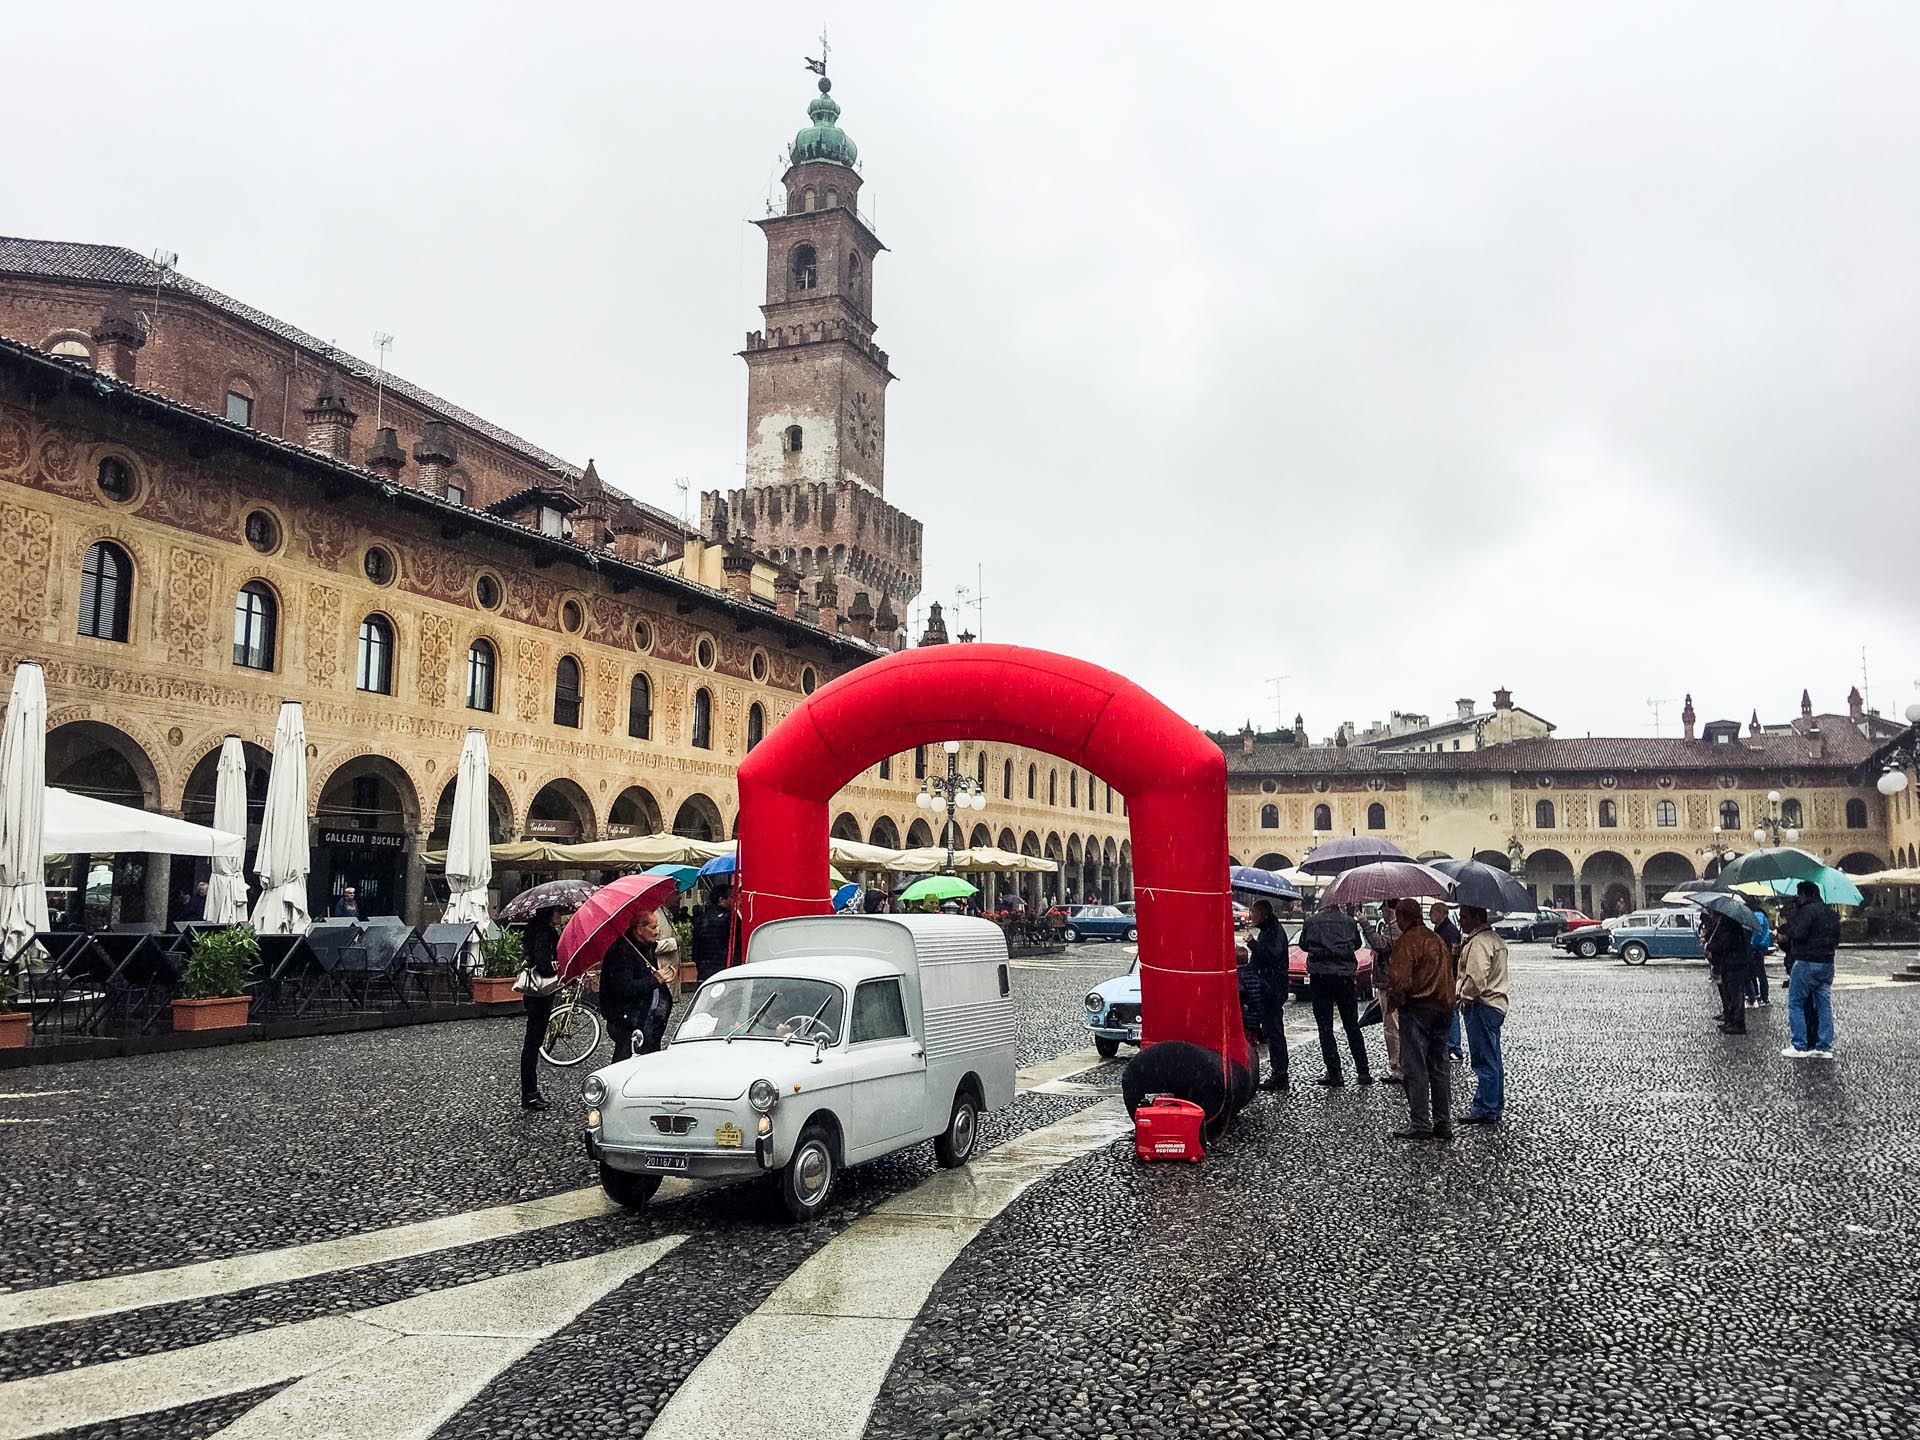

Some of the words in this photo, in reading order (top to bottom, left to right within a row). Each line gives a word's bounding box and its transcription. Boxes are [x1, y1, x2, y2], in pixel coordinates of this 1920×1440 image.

[530, 822, 556, 832] Gelateria
[325, 833, 365, 844] GALLERIA
[371, 836, 401, 846] DUCALE
[646, 1156, 672, 1167] 201167
